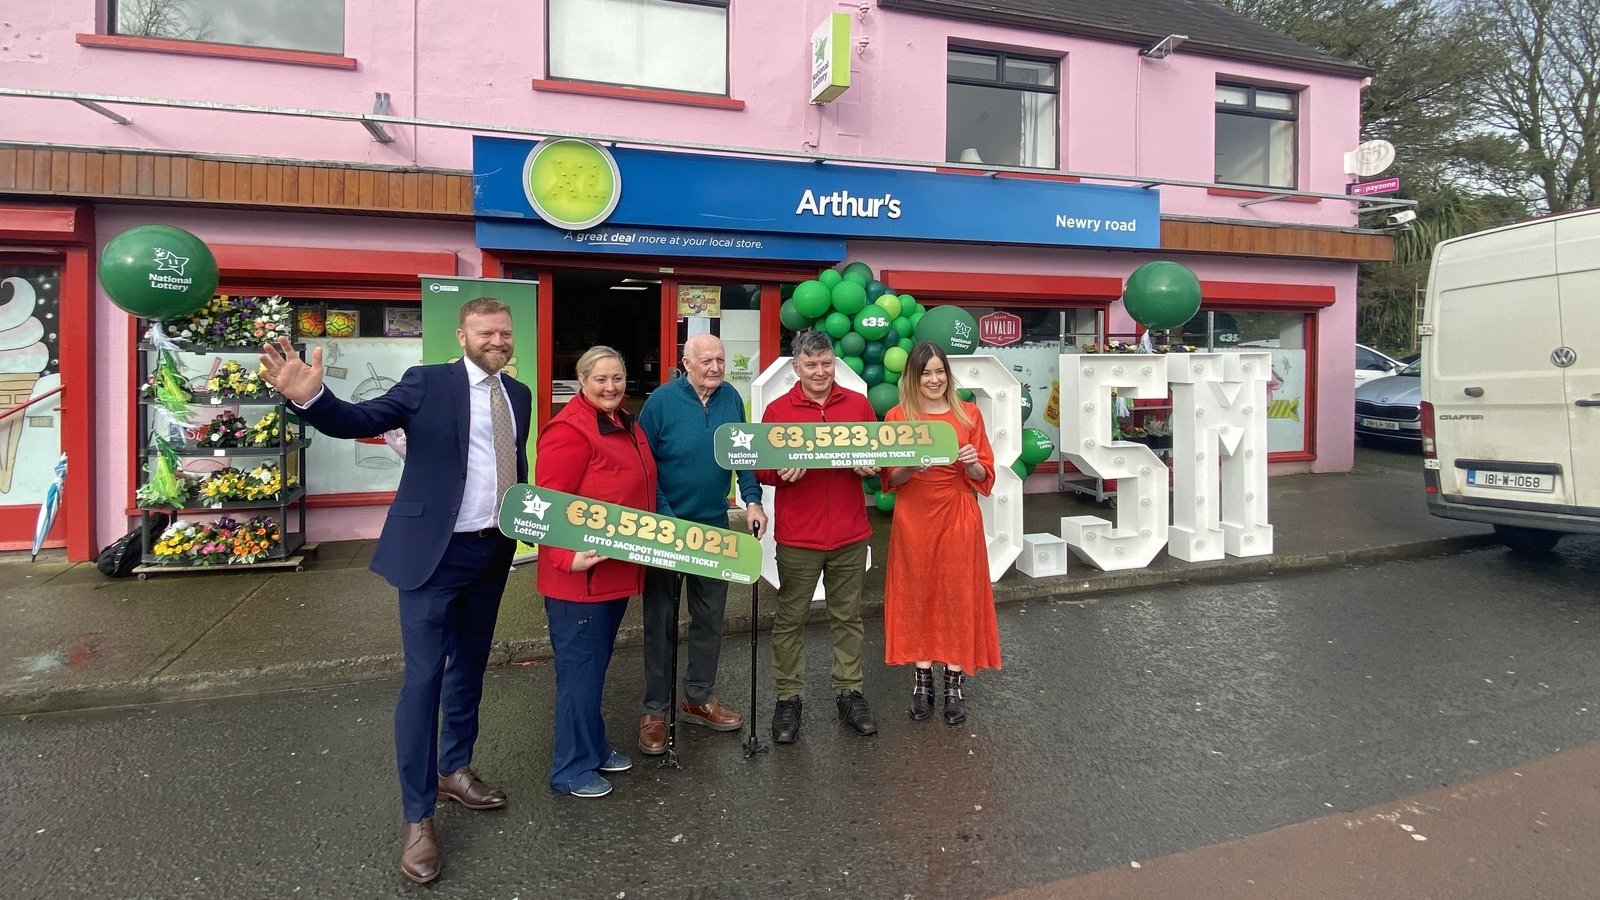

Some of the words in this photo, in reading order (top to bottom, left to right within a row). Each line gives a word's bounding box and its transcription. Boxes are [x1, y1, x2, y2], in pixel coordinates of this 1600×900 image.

[1365, 181, 1396, 193] payzone
[795, 189, 902, 219] Arthur's
[1055, 214, 1100, 232] Newry
[1105, 218, 1136, 232] road
[564, 231, 573, 240] A
[576, 232, 608, 243] great
[611, 233, 636, 243] deal
[638, 235, 667, 244] more
[669, 235, 680, 245] at
[682, 237, 707, 247] your
[709, 237, 733, 247] local
[735, 239, 764, 249] store.
[148, 273, 193, 284] National
[151, 281, 189, 293] Lottery
[950, 336, 972, 345] National
[950, 341, 970, 350] Lottery
[768, 424, 934, 452] €3,523,021
[727, 451, 759, 460] National
[730, 458, 757, 466] Lottery
[788, 452, 814, 460] LOTTO
[815, 452, 851, 460] JACKPOT
[851, 451, 888, 459] WINNING
[888, 450, 916, 458] TICKET
[831, 459, 851, 467] SOLD
[1484, 473, 1540, 488] 181-W-1068
[513, 517, 550, 532] National
[565, 500, 739, 559] €3,523,021
[514, 525, 547, 540] Lottery
[583, 534, 612, 547] LOTTO
[612, 539, 652, 555] JACKPOT
[653, 547, 690, 562] WINNING
[690, 555, 719, 569] TICKET
[628, 552, 651, 564] SOLD
[651, 556, 676, 568] HERE!
